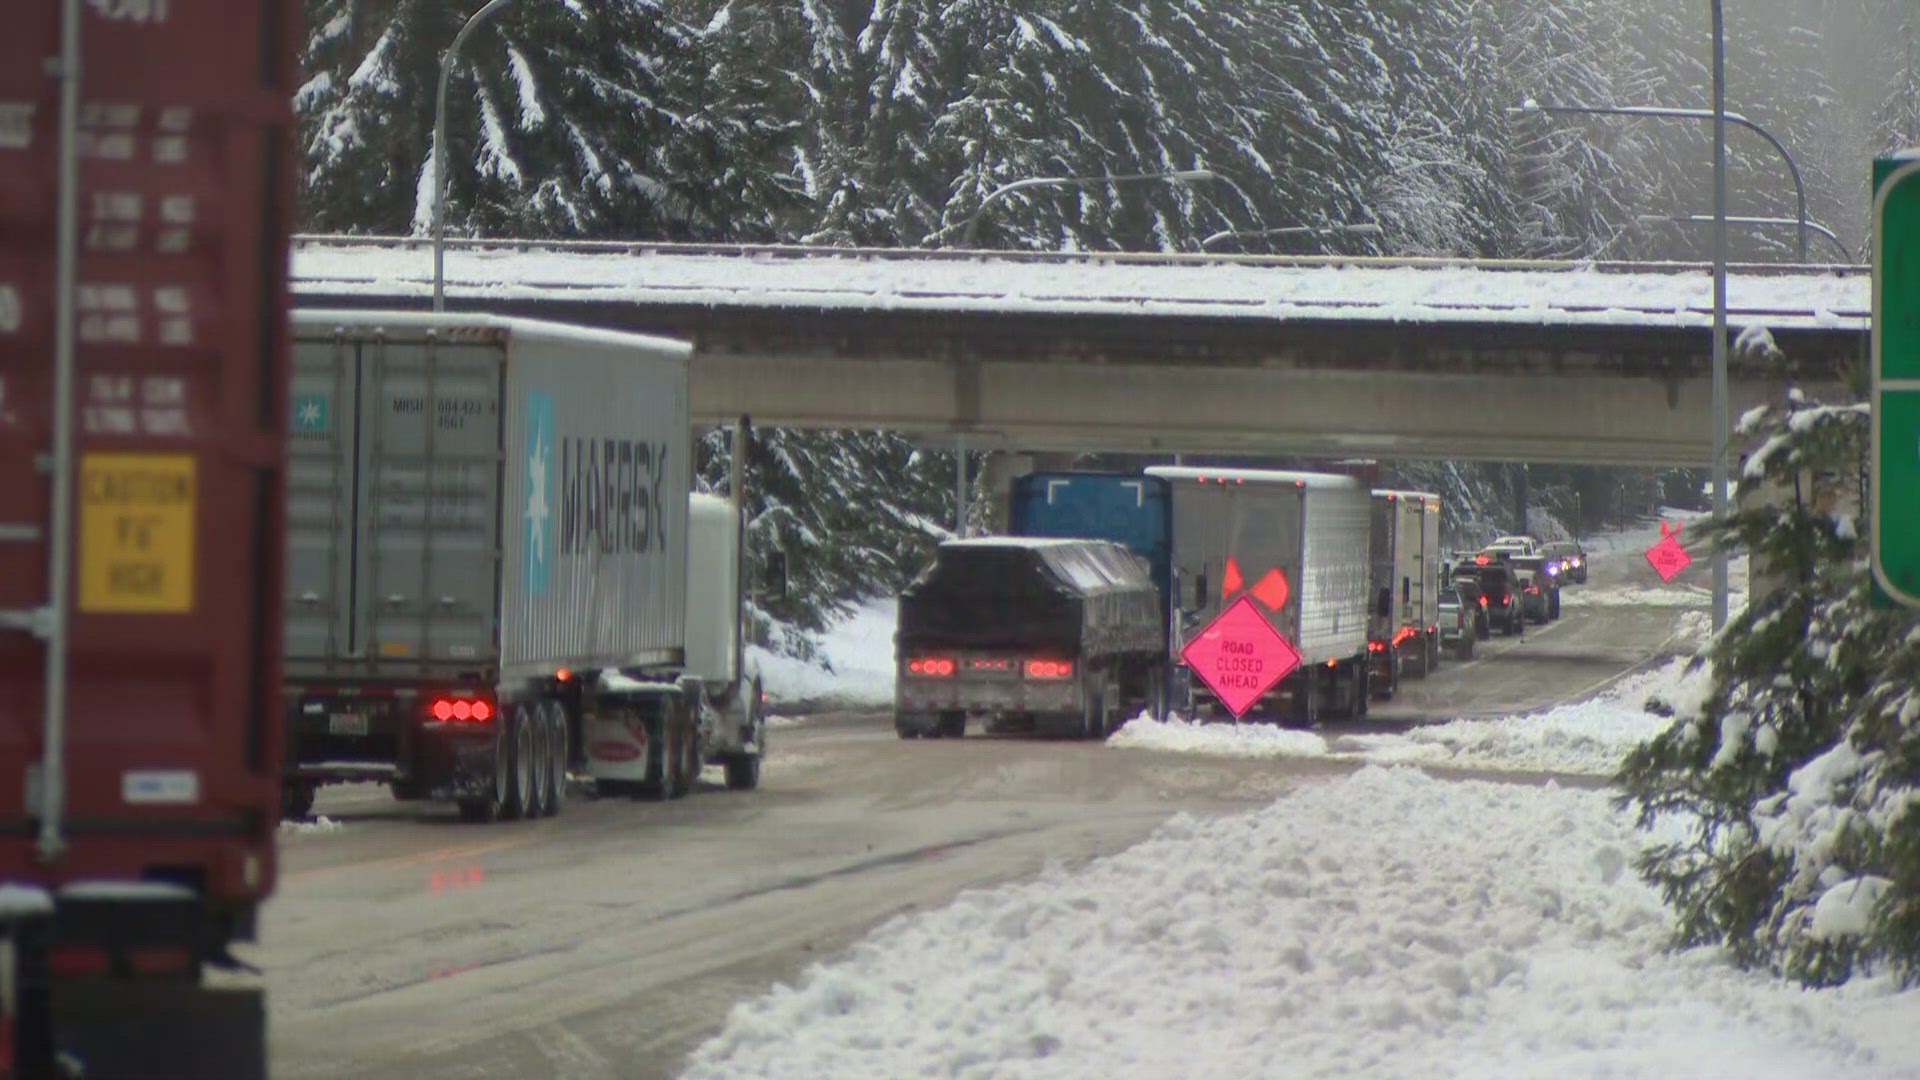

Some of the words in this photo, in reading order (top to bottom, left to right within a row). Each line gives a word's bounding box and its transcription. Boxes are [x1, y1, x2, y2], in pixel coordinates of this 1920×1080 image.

[561, 437, 667, 554] MAERSK
[1221, 640, 1254, 655] ROAD
[1217, 657, 1263, 672] CLOSED
[1219, 675, 1259, 689] AHEAD
